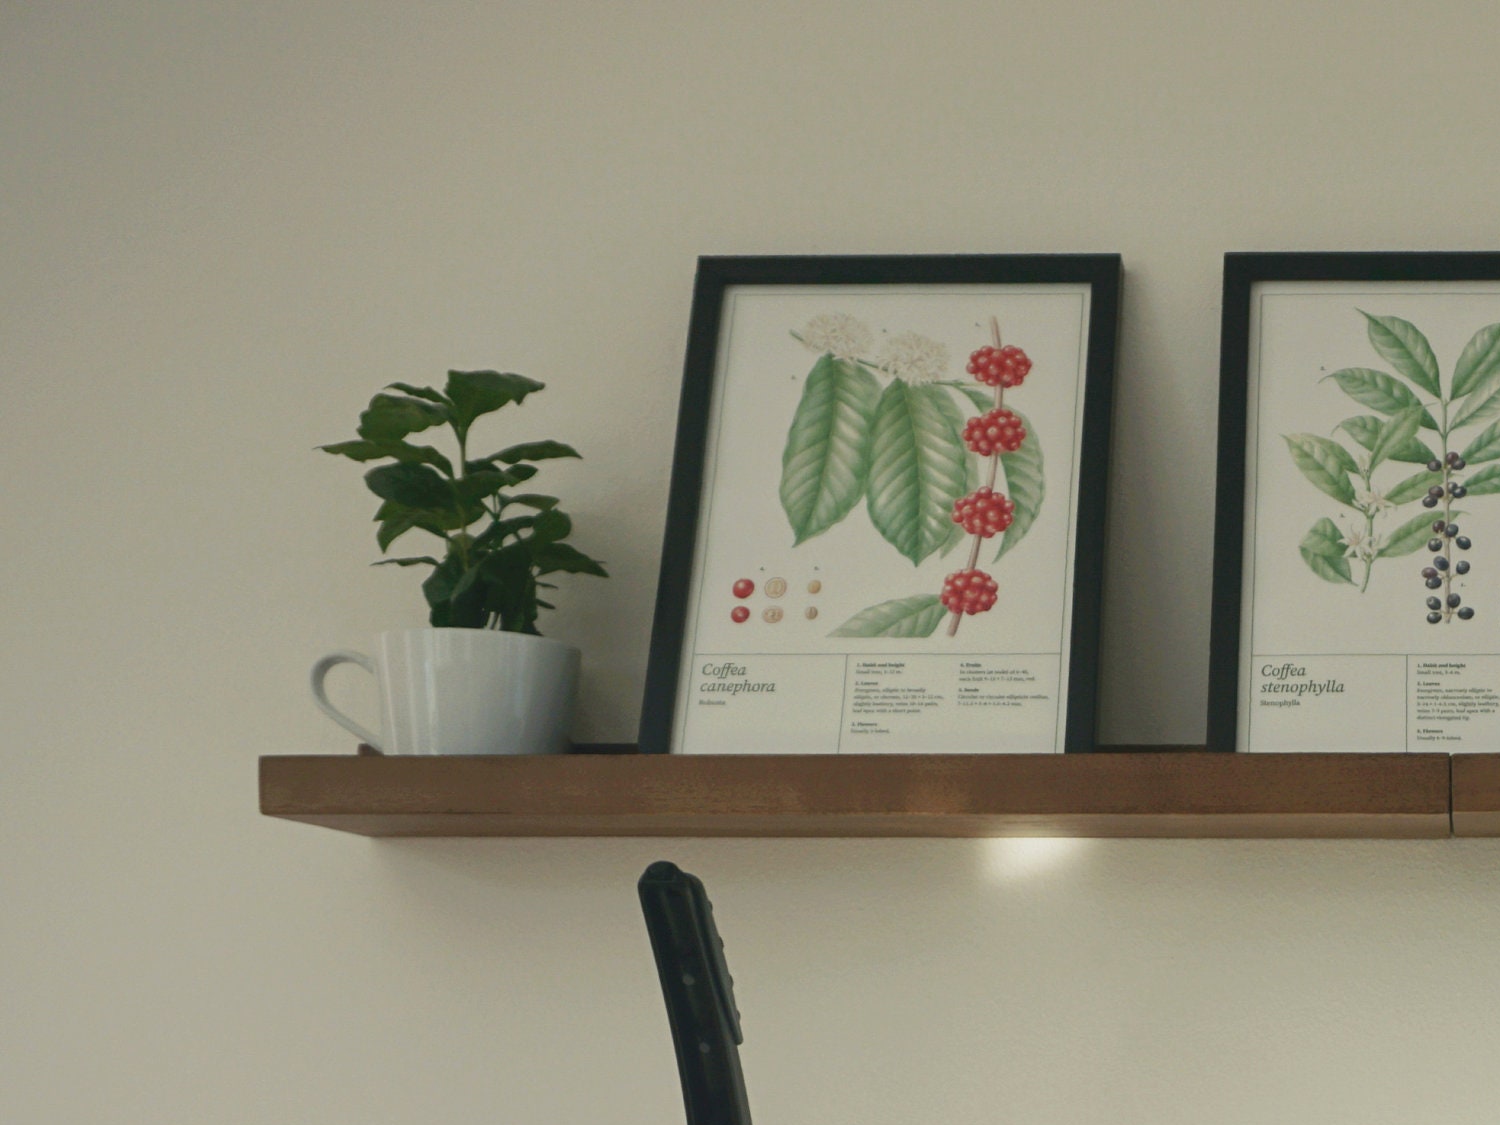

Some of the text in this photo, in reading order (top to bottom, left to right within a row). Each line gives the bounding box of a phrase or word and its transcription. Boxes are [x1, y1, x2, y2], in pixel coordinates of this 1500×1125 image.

[702, 663, 746, 679] Coffea
[1261, 663, 1306, 680] Coffea
[700, 680, 776, 696] canephora
[1261, 680, 1344, 696] stenophylla
